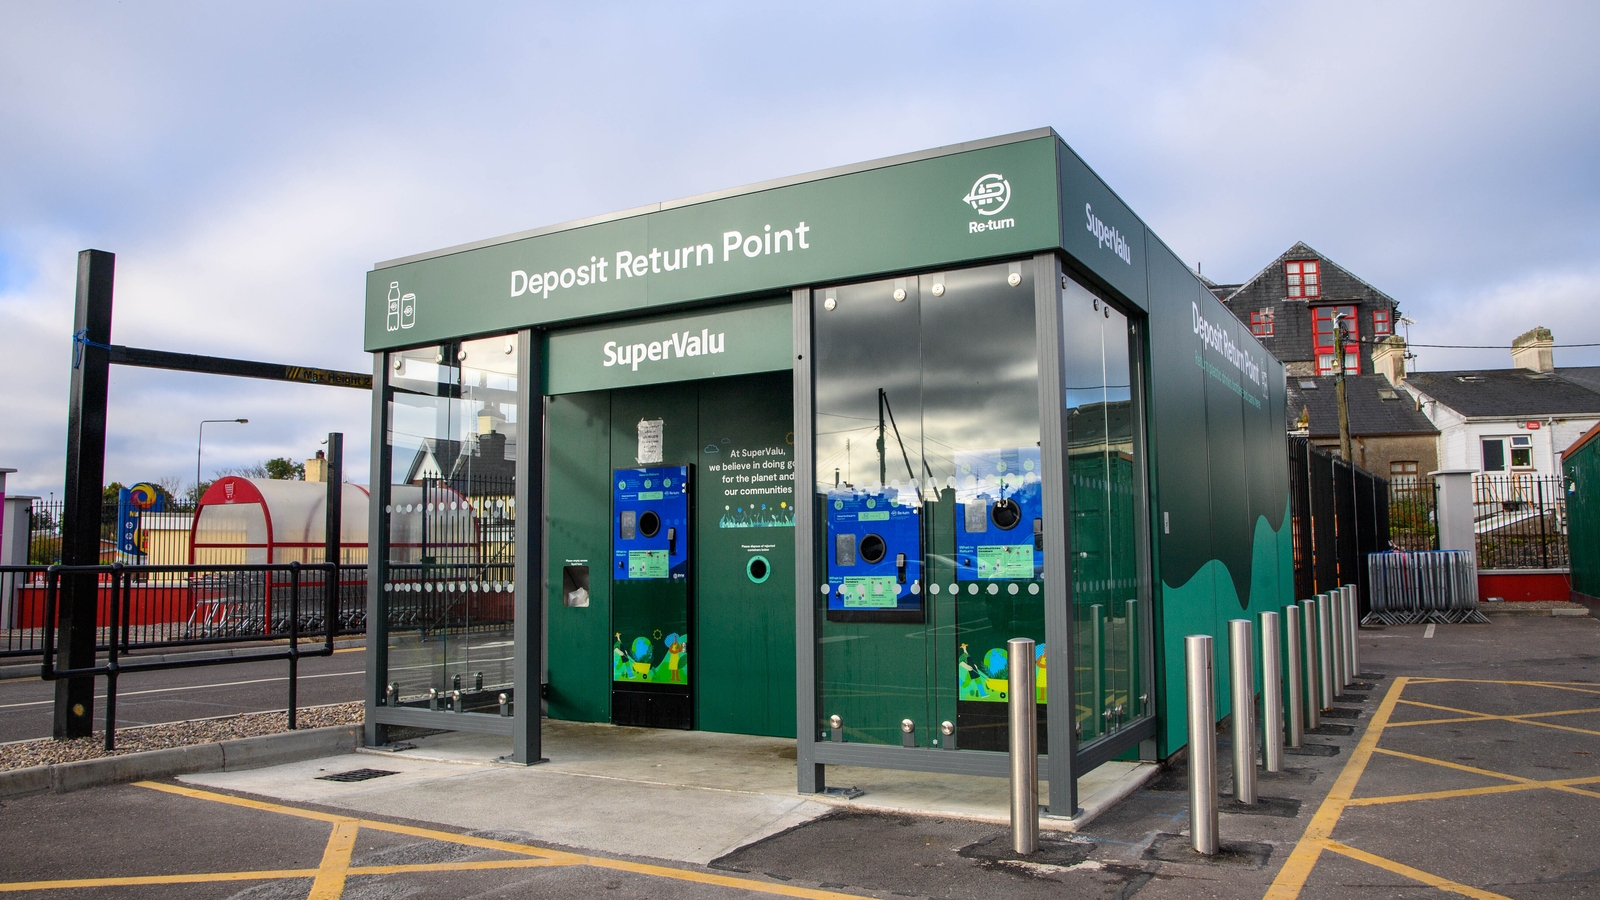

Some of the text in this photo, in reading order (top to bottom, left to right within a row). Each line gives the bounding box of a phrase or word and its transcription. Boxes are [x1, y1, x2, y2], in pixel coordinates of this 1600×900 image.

[968, 217, 1015, 234] Re-turn
[1085, 202, 1132, 266] SuperValu
[510, 220, 811, 301] Deposit Return Point
[602, 328, 726, 372] SuperValu
[1192, 300, 1260, 386] Deposit Return Point
[303, 370, 326, 382] Max
[328, 373, 362, 386] Height
[730, 446, 786, 459] At SuperValu,
[709, 463, 721, 472] we
[722, 461, 751, 471] believe
[752, 461, 761, 469] in
[762, 459, 786, 470] doing
[721, 472, 795, 484] for the planet and
[724, 485, 793, 496] our communities
